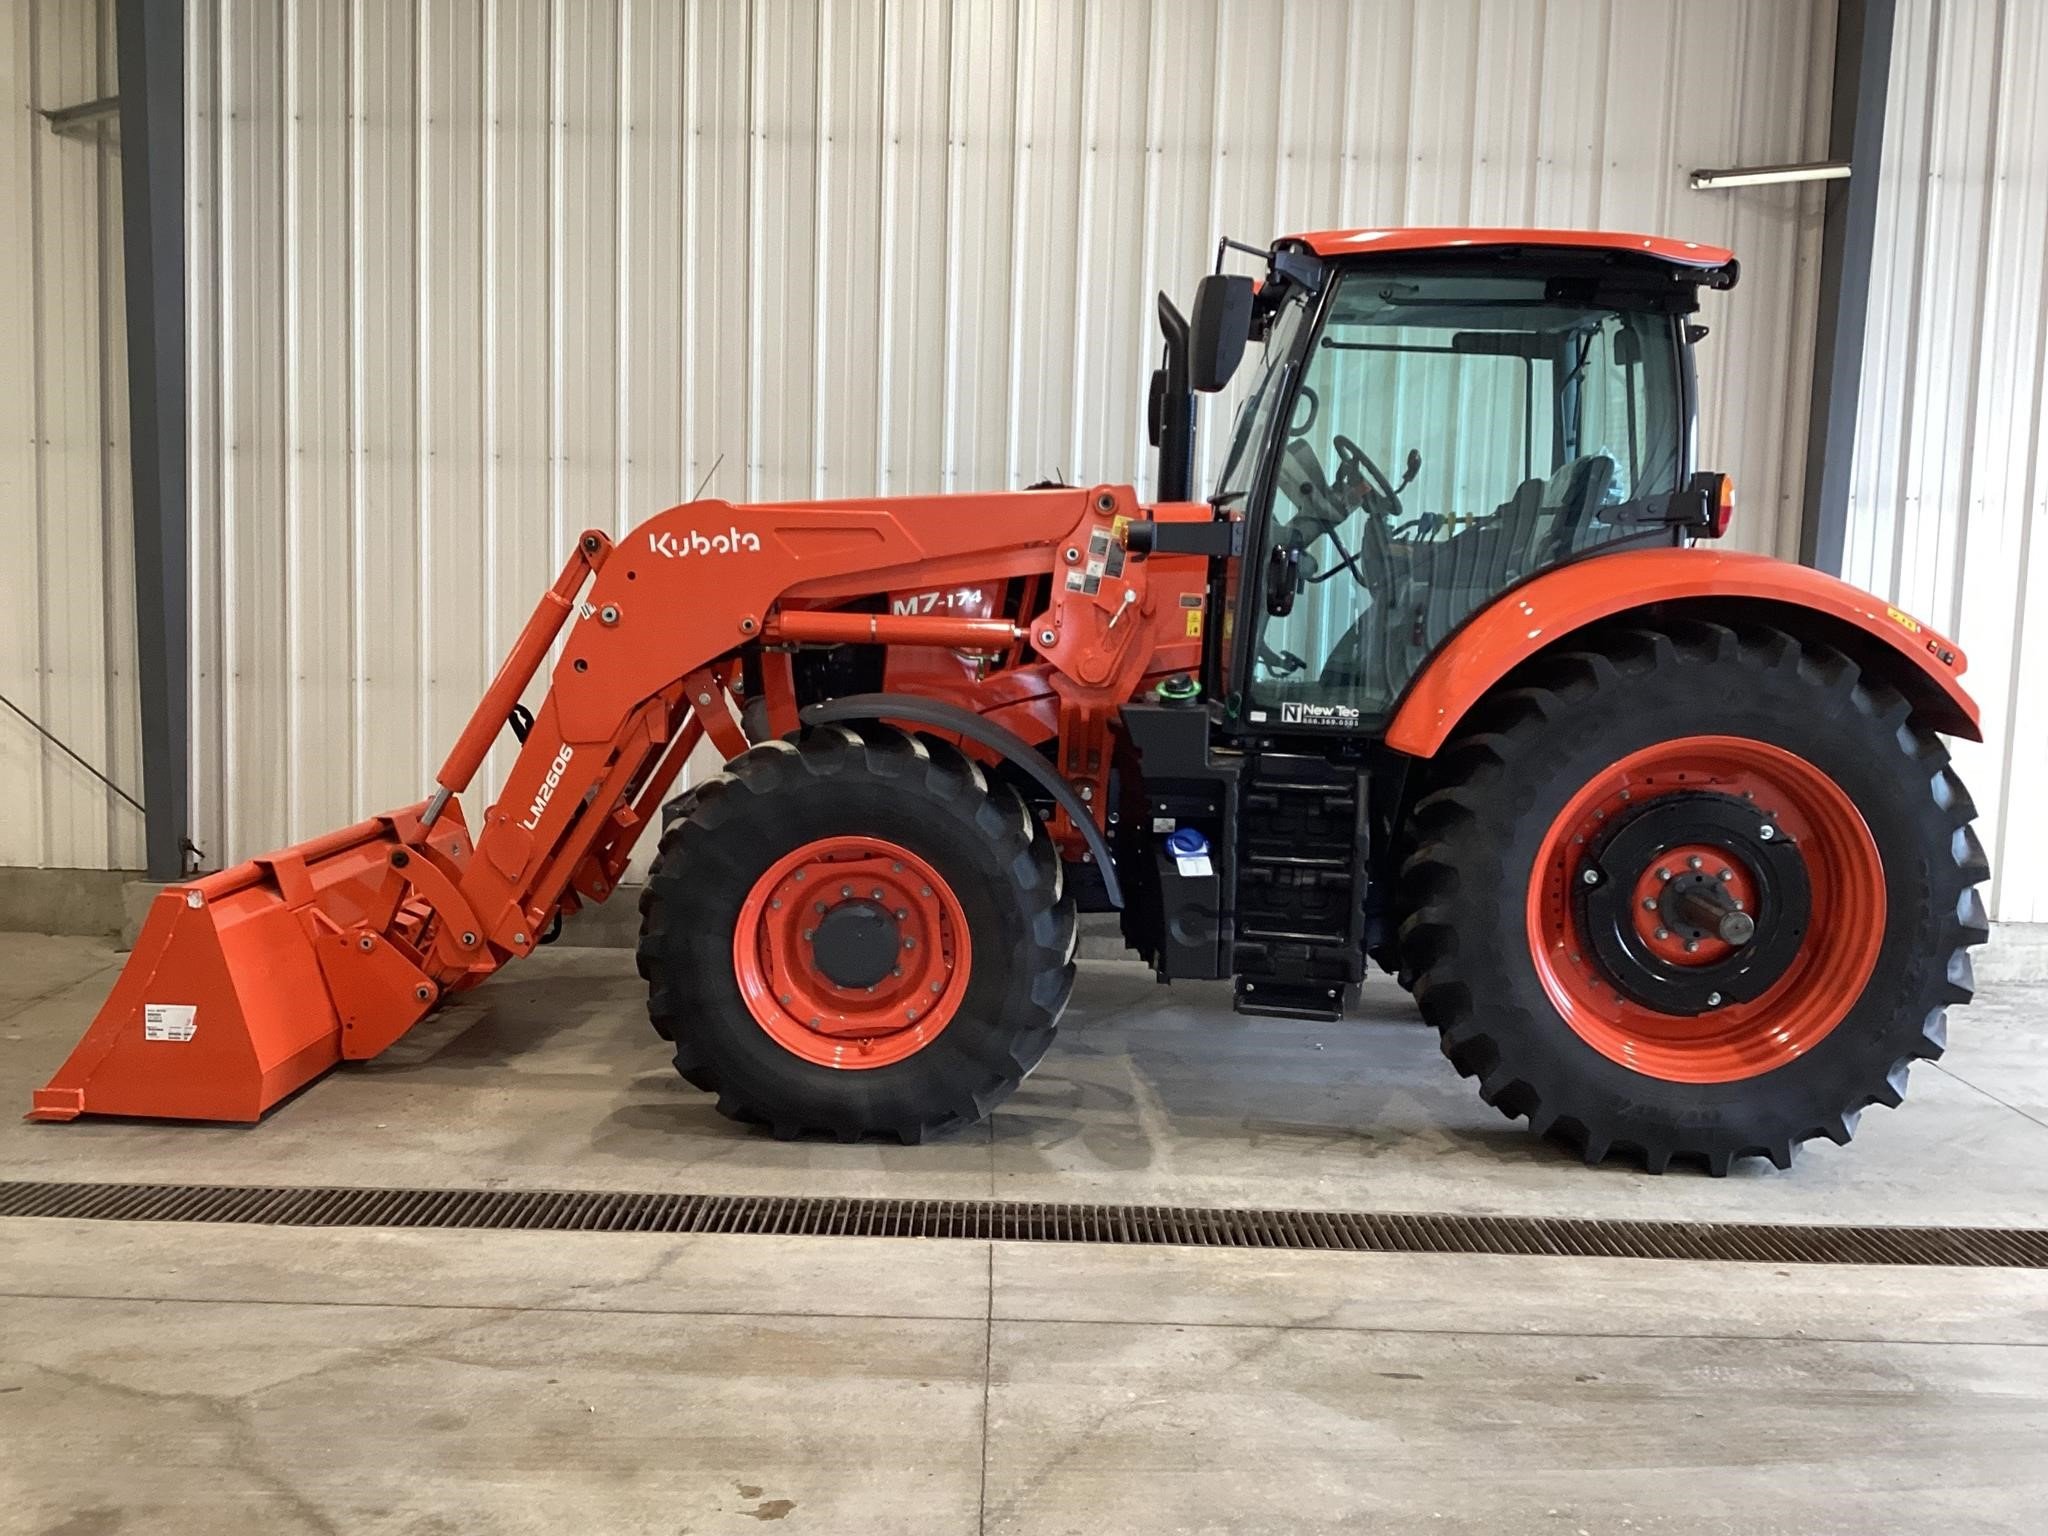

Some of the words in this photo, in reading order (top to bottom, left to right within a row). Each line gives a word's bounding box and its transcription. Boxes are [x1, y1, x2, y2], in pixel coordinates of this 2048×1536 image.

[649, 526, 760, 558] Kubota
[893, 589, 983, 616] M7-174
[1303, 704, 1334, 716] New
[1336, 705, 1359, 717] Tec
[523, 742, 574, 830] LM2606
